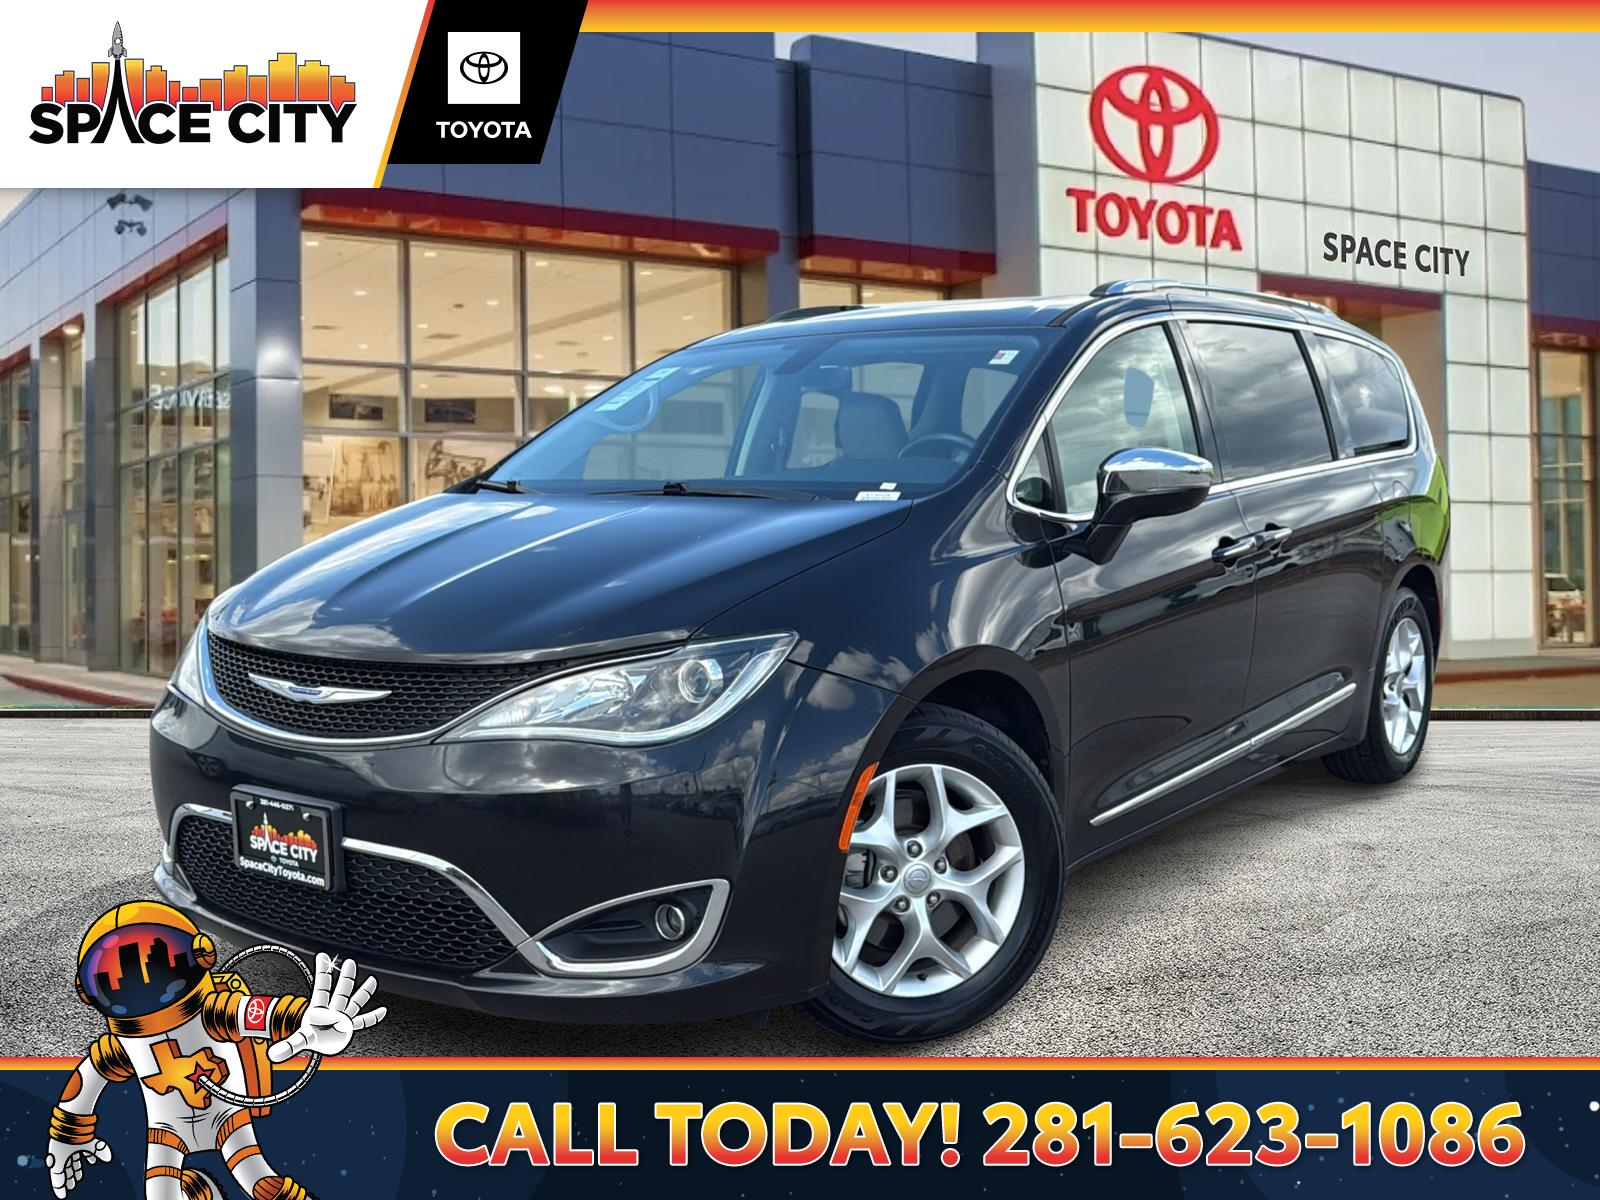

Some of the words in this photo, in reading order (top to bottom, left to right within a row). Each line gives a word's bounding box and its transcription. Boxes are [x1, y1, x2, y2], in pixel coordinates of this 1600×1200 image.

[1066, 187, 1242, 251] TOYOTA
[1323, 232, 1407, 270] SPACE
[1414, 244, 1470, 277] CITY
[250, 826, 288, 856] SPACE
[290, 844, 318, 863] CITY
[240, 856, 325, 886] SpaceCityToyota.com
